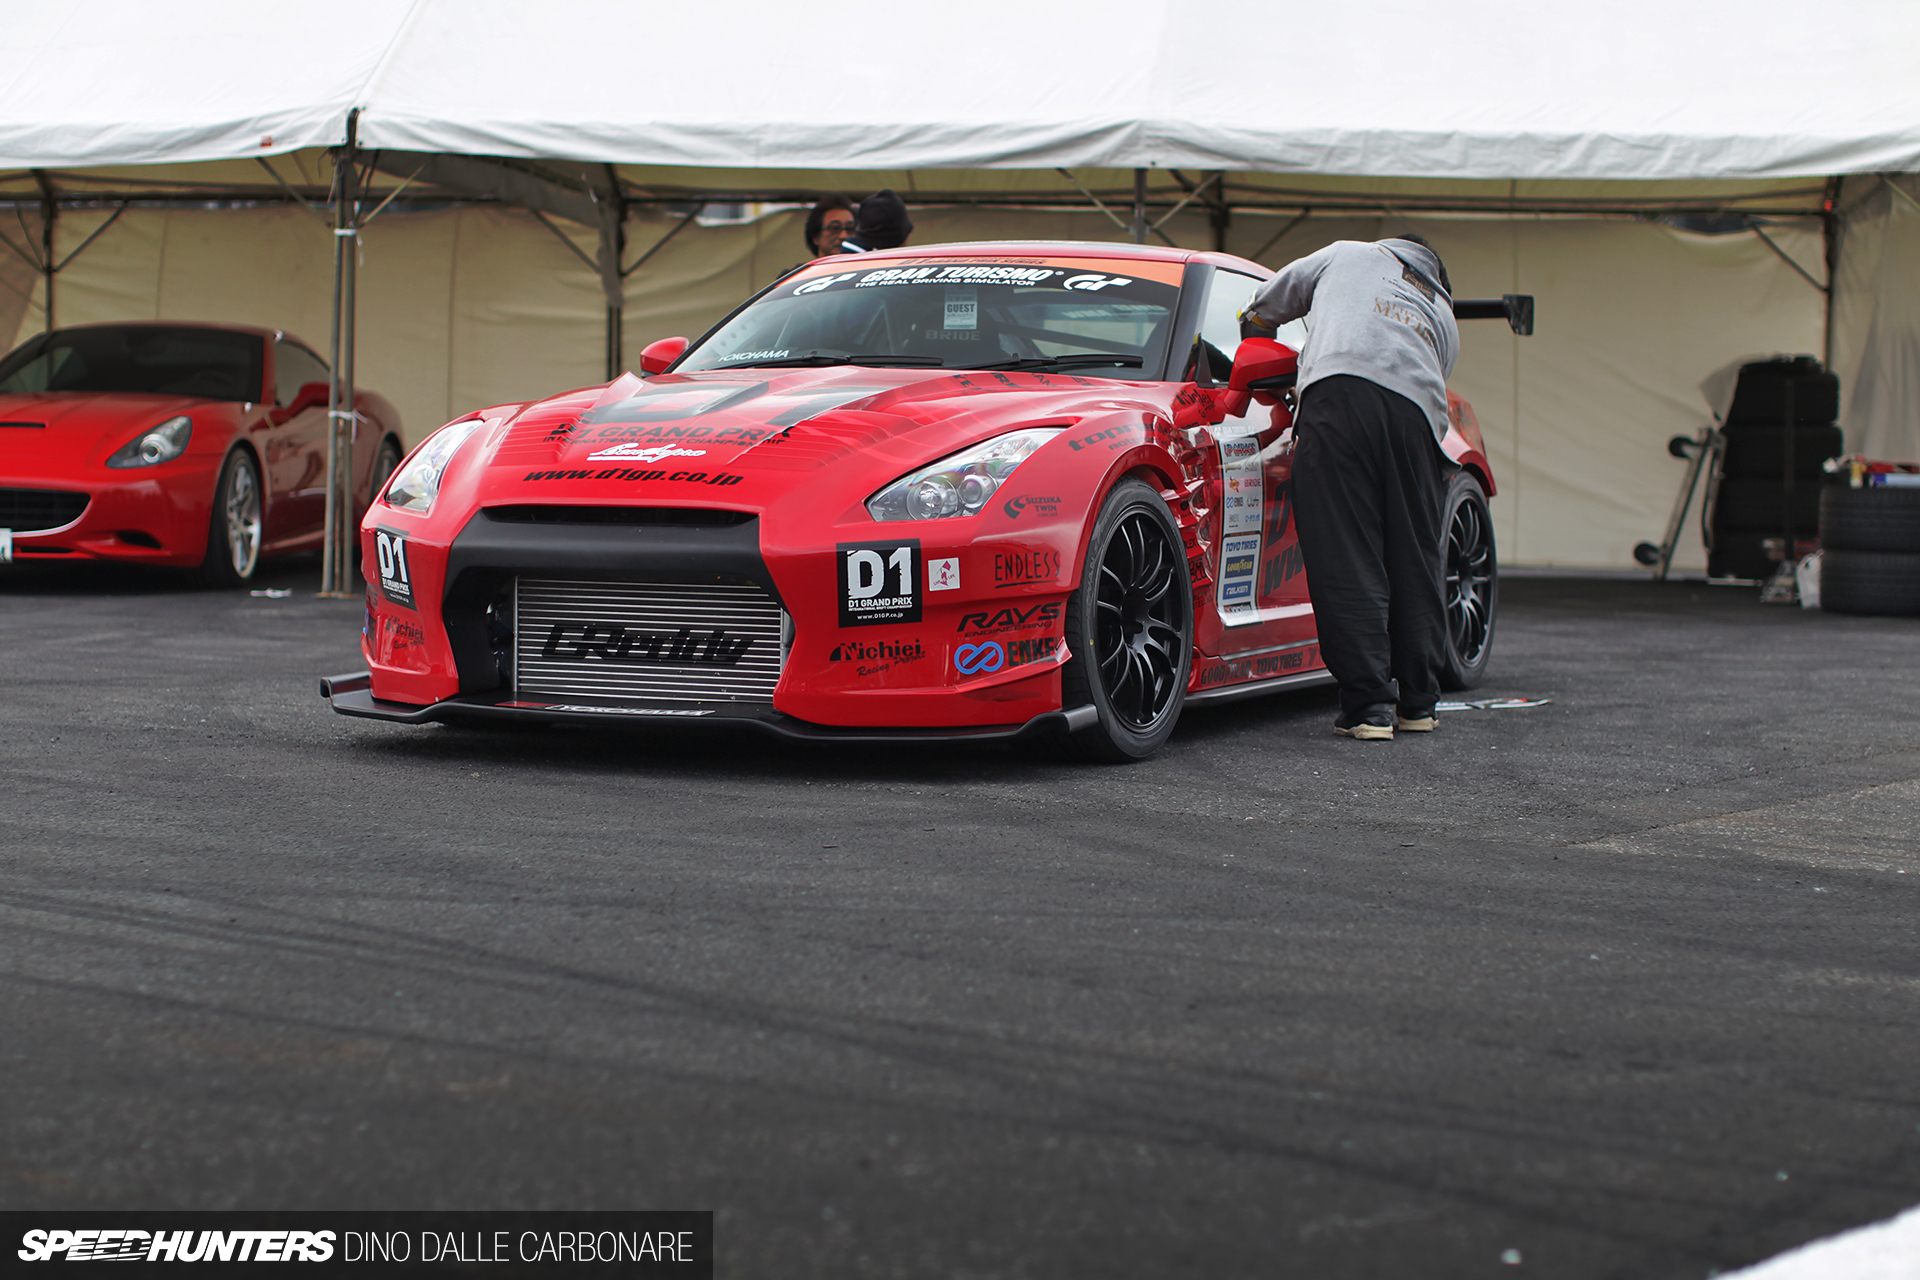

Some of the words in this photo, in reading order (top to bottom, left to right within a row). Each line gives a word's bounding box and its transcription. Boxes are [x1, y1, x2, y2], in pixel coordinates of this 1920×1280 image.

[861, 267, 938, 283] GRAN
[936, 266, 1054, 281] TURISMO
[957, 278, 1036, 287] SIMULATOR
[947, 304, 975, 313] GUEST
[925, 330, 981, 341] BRIDE
[718, 350, 790, 362] YOKOHAMA
[597, 427, 715, 438] GRAND
[522, 467, 744, 486] www.d1gp.co.jp
[1025, 496, 1062, 505] SUZUKA
[1035, 504, 1057, 512] TWIN
[1226, 541, 1242, 552] TOYO
[1241, 539, 1258, 550] TIRES
[377, 531, 408, 583] D1
[995, 552, 1060, 581] ENDLESS
[1227, 558, 1253, 573] GOODYEAR
[847, 547, 913, 600] D1
[848, 600, 859, 608] D1
[860, 598, 891, 607] GRAND
[892, 597, 913, 605] PRIX
[957, 602, 1062, 633] RAYS
[964, 621, 1053, 638] ENGINEERING
[829, 639, 921, 662] Nichiei
[1257, 656, 1279, 674] TOYO
[1279, 651, 1304, 669] TIRES
[857, 663, 890, 678] Racing
